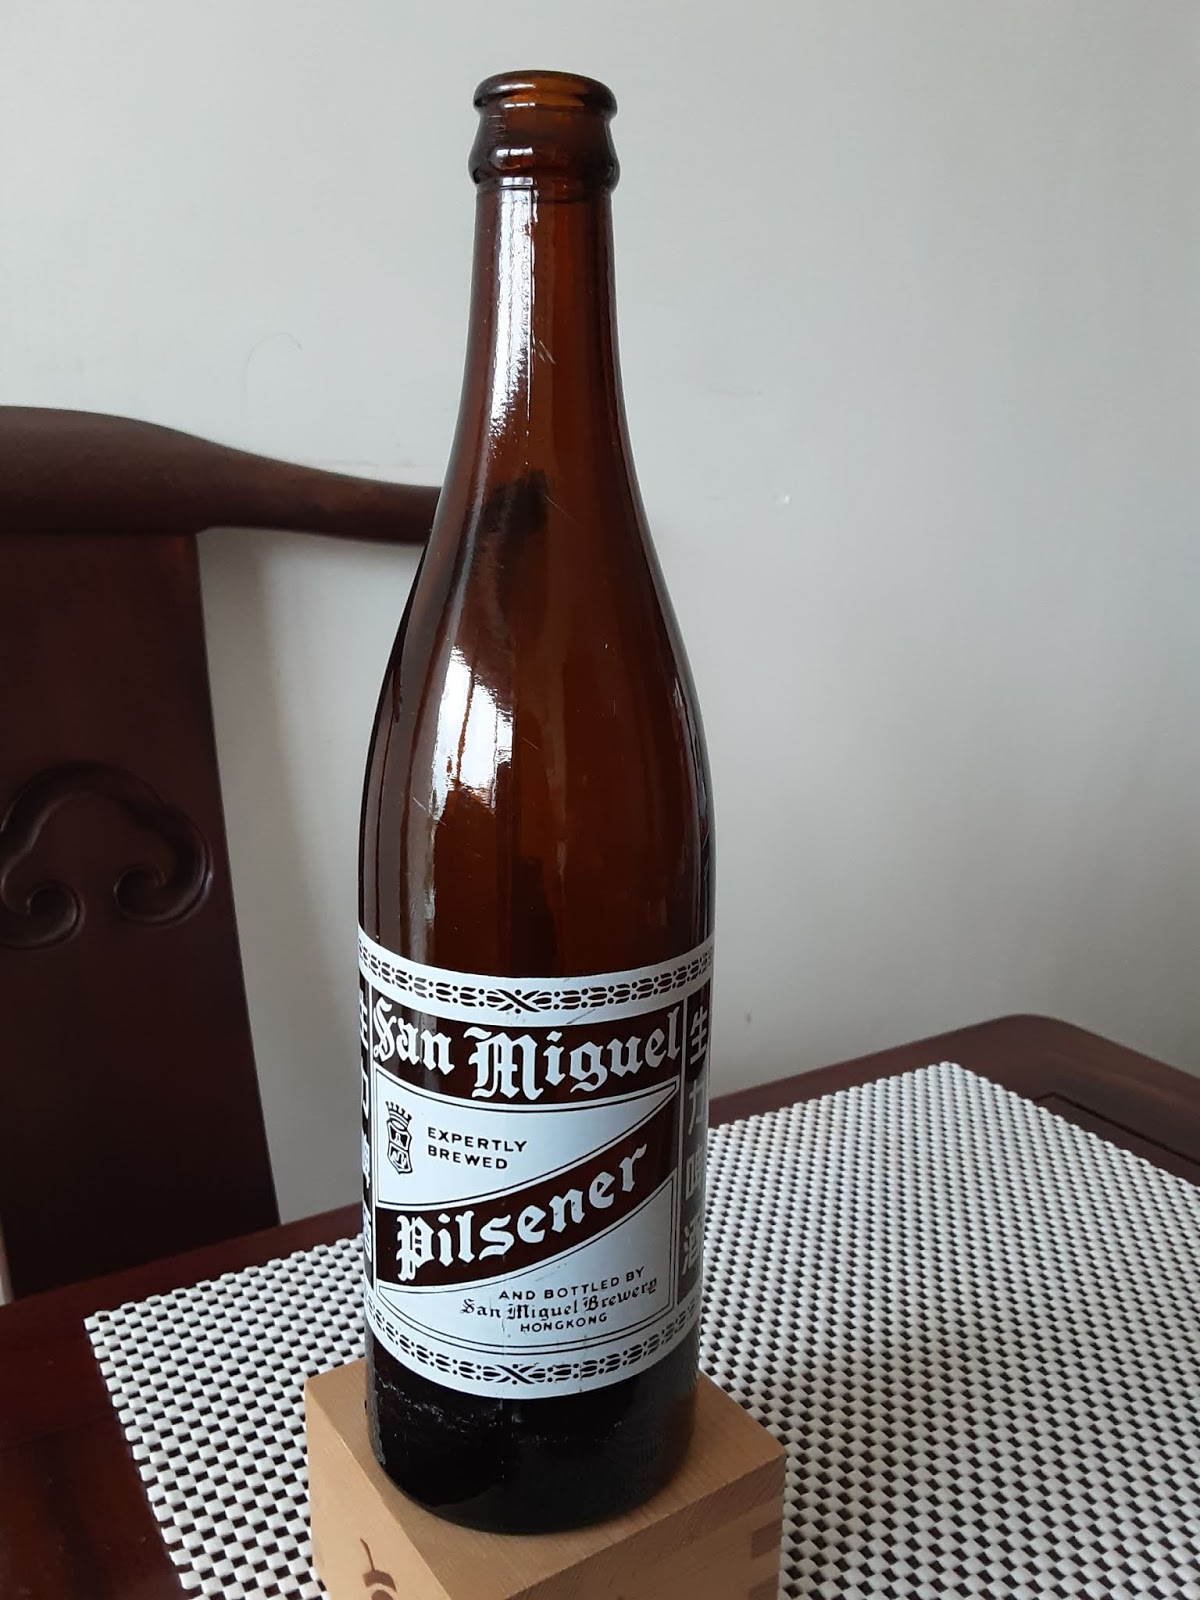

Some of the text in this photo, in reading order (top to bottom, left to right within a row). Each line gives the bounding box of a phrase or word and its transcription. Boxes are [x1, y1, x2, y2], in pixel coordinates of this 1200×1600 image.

[373, 997, 681, 1100] San Miguel
[427, 1126, 528, 1153] EXPERTLY
[427, 1145, 508, 1170] BREWED
[396, 1143, 647, 1281] Pilsener
[460, 1277, 658, 1322] San Miguel Brewery
[498, 1266, 645, 1301] AND BOTTLED BY
[520, 1312, 608, 1333] HONGKONG
